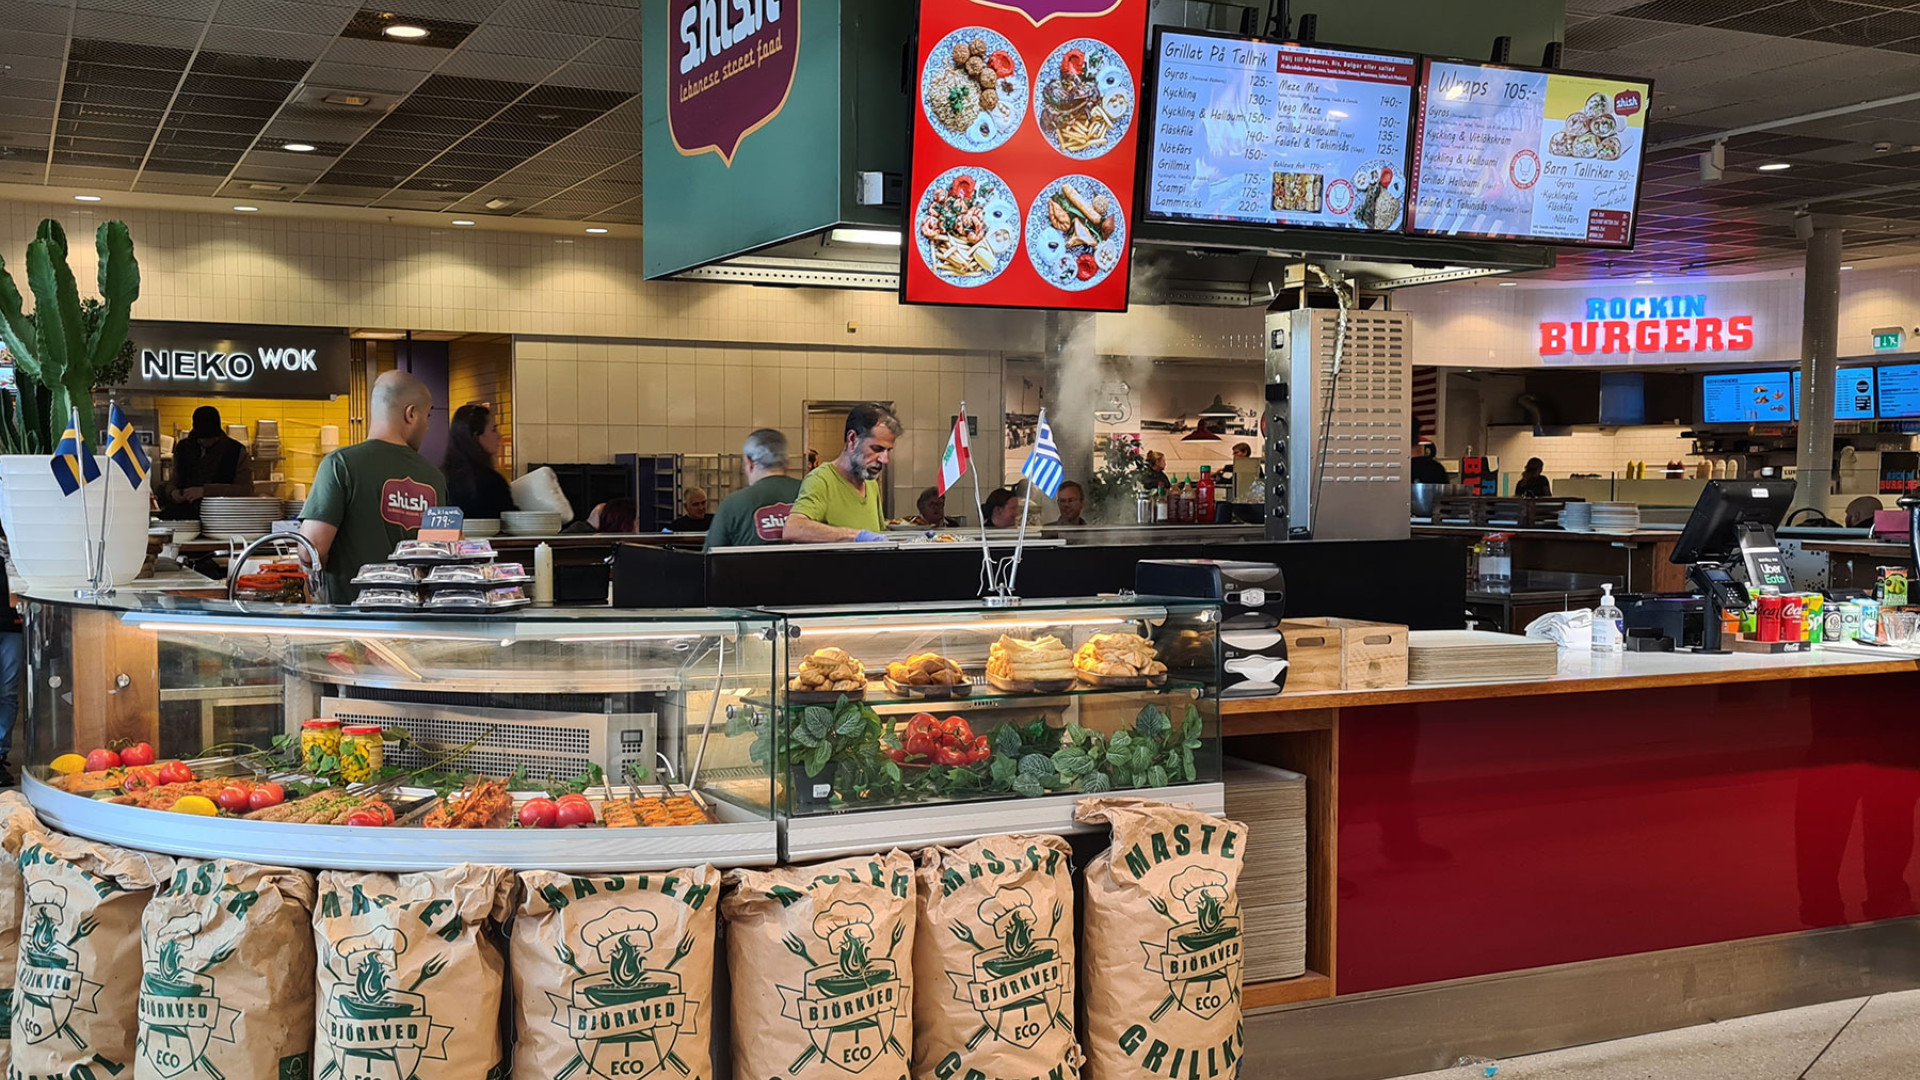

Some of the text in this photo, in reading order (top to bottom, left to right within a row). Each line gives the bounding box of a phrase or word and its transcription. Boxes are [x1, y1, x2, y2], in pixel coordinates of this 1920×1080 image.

[1165, 41, 1268, 67] Grillat På Tallrik
[680, 28, 783, 103] lebanese street food
[1164, 67, 1188, 81] Gyros
[1249, 75, 1273, 88] 125:-
[1162, 86, 1197, 102] Kyckling
[1248, 93, 1272, 106] 130:-
[1304, 81, 1320, 94] Mix
[1380, 96, 1402, 108] 140:-
[1504, 82, 1537, 101] 105:-
[1161, 105, 1196, 121] Kyckling
[1199, 107, 1206, 119] &
[1210, 109, 1247, 122] Halloumi
[1247, 112, 1272, 124] 150:-
[1278, 101, 1297, 114] Vego
[1379, 116, 1401, 129] 130:-
[1428, 105, 1450, 119] Gyros
[1245, 130, 1269, 142] 140:-
[1276, 121, 1302, 134] Grillad
[1305, 124, 1340, 137] Halloumi
[1426, 128, 1456, 143] Kyckling
[1459, 131, 1465, 141] &
[1159, 141, 1268, 160] Nötfärs 150:-
[1275, 135, 1300, 148] Falafel
[1304, 137, 1311, 149] &
[1158, 158, 1190, 171] Grillmix
[1423, 151, 1498, 167] Kyckling & Halloumi
[1543, 160, 1567, 176] Barn
[1574, 162, 1614, 179] Tallrikar
[1156, 181, 1187, 196] Scampi
[1155, 195, 1202, 209] Lammracks
[1585, 295, 1707, 320] ROCKIN
[1539, 316, 1754, 356] BURGERS
[141, 346, 318, 381] NEKO WOK
[388, 490, 428, 511] shish
[761, 514, 788, 529] shi
[1760, 563, 1781, 574] Uber
[1764, 574, 1786, 584] Eats
[1124, 823, 1238, 880] MASTE
[1170, 942, 1239, 975] BJÖRKVED
[979, 966, 1058, 1003] BJÖRKVED
[809, 987, 893, 1021] BJÖRKVED
[1196, 995, 1221, 1011] ECO
[578, 1002, 675, 1030] BJÖRKVED
[24, 1018, 42, 1037] ECO
[331, 1023, 418, 1042] BJÖRKVED
[1014, 1023, 1040, 1041] ECO
[156, 1049, 180, 1068] ECO
[844, 1047, 871, 1063] ECO
[611, 1060, 644, 1076] ECO
